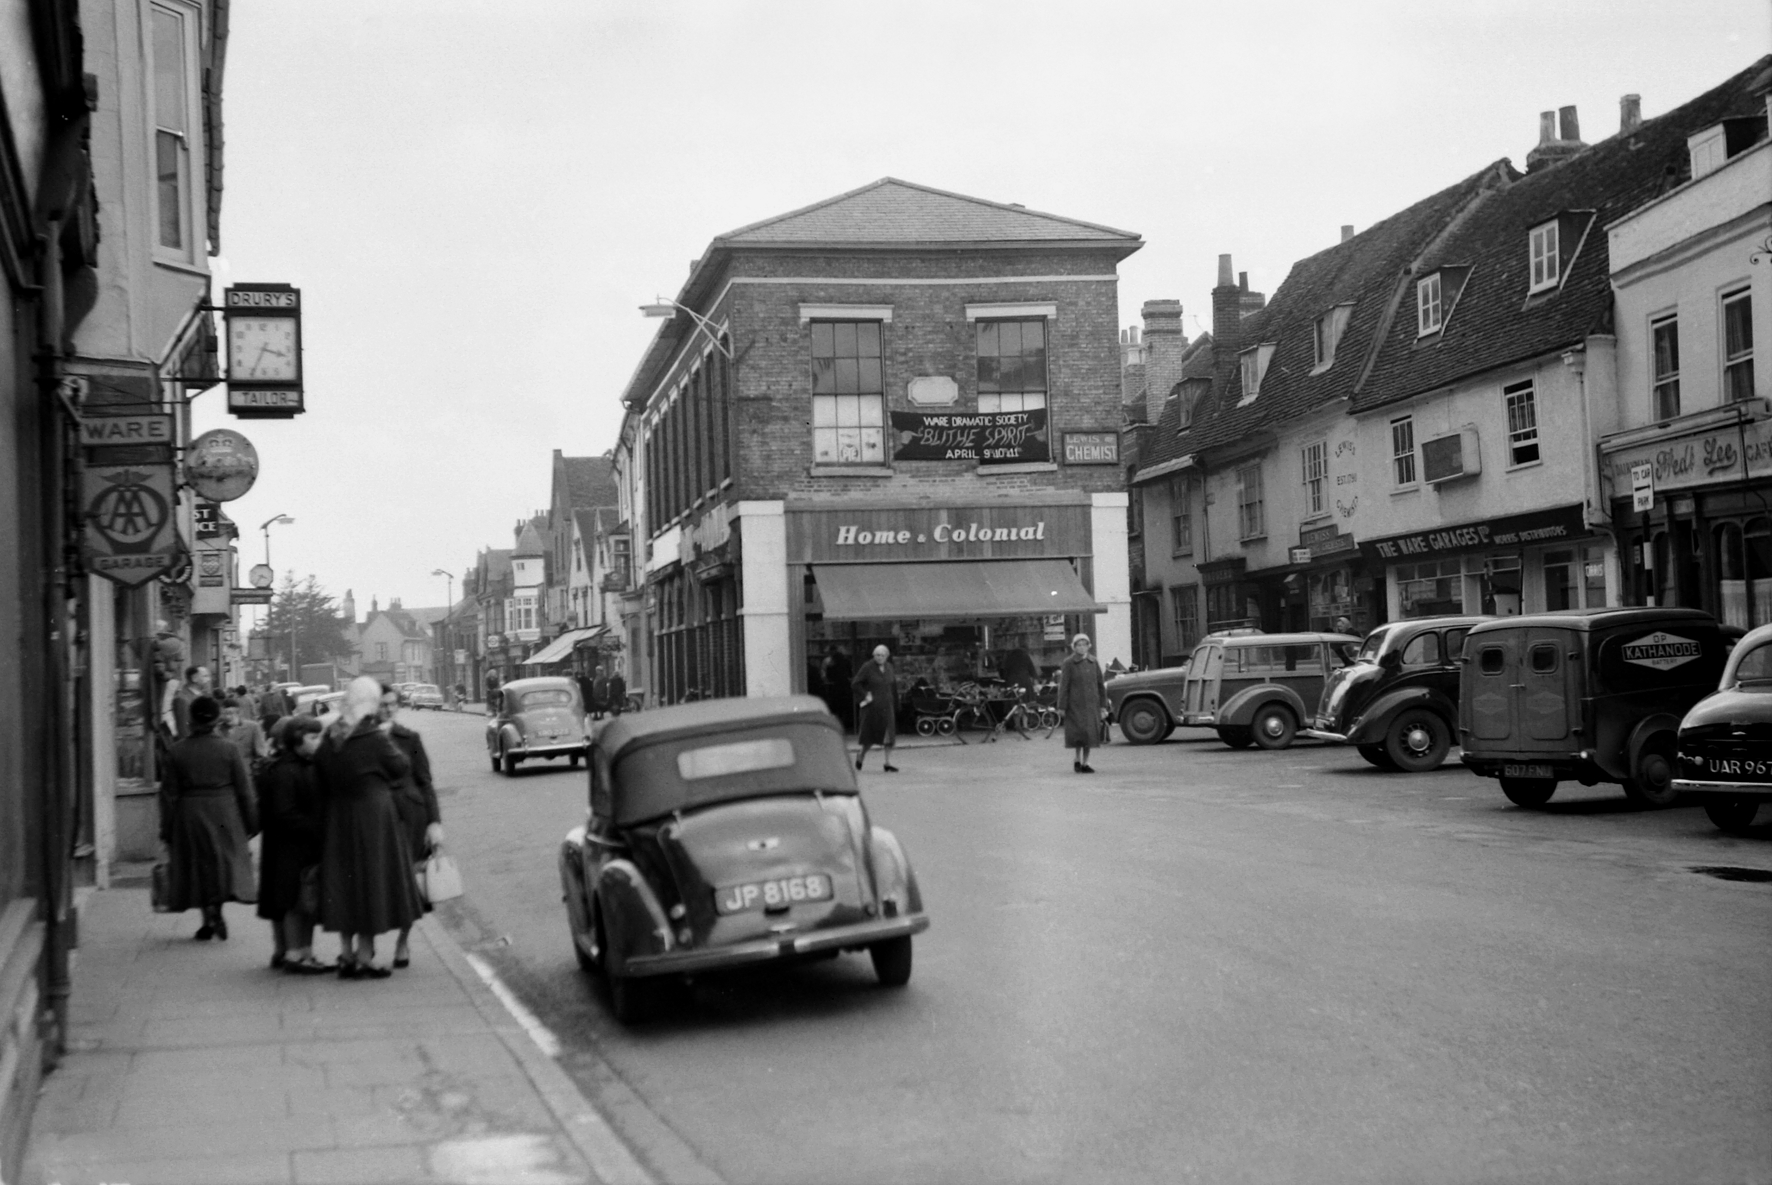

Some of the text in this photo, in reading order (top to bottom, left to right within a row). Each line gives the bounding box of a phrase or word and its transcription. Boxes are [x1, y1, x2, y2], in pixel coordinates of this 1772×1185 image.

[242, 392, 288, 405] TAILOR
[923, 413, 1029, 427] WARE DRAMATIC SOCIETY
[84, 420, 164, 439] WARE
[920, 425, 1031, 447] BLITHE SPIRIT
[1066, 434, 1100, 444] LEWIS
[946, 448, 980, 459] APRIL
[1066, 445, 1117, 460] CHEMIST
[1703, 438, 1738, 476] Lee
[1637, 496, 1650, 507] PARK
[104, 489, 156, 534] AA
[836, 522, 1045, 545] Home & Colonial
[1375, 541, 1398, 558] THE
[1397, 535, 1429, 554] WARE
[1429, 527, 1479, 550] GARAGES
[100, 556, 165, 570] GARAGE
[1625, 643, 1699, 659] KATHANODE
[1652, 658, 1678, 666] BATTERY
[1709, 759, 1772, 775] UAR 967
[726, 875, 822, 910] JP 8168
